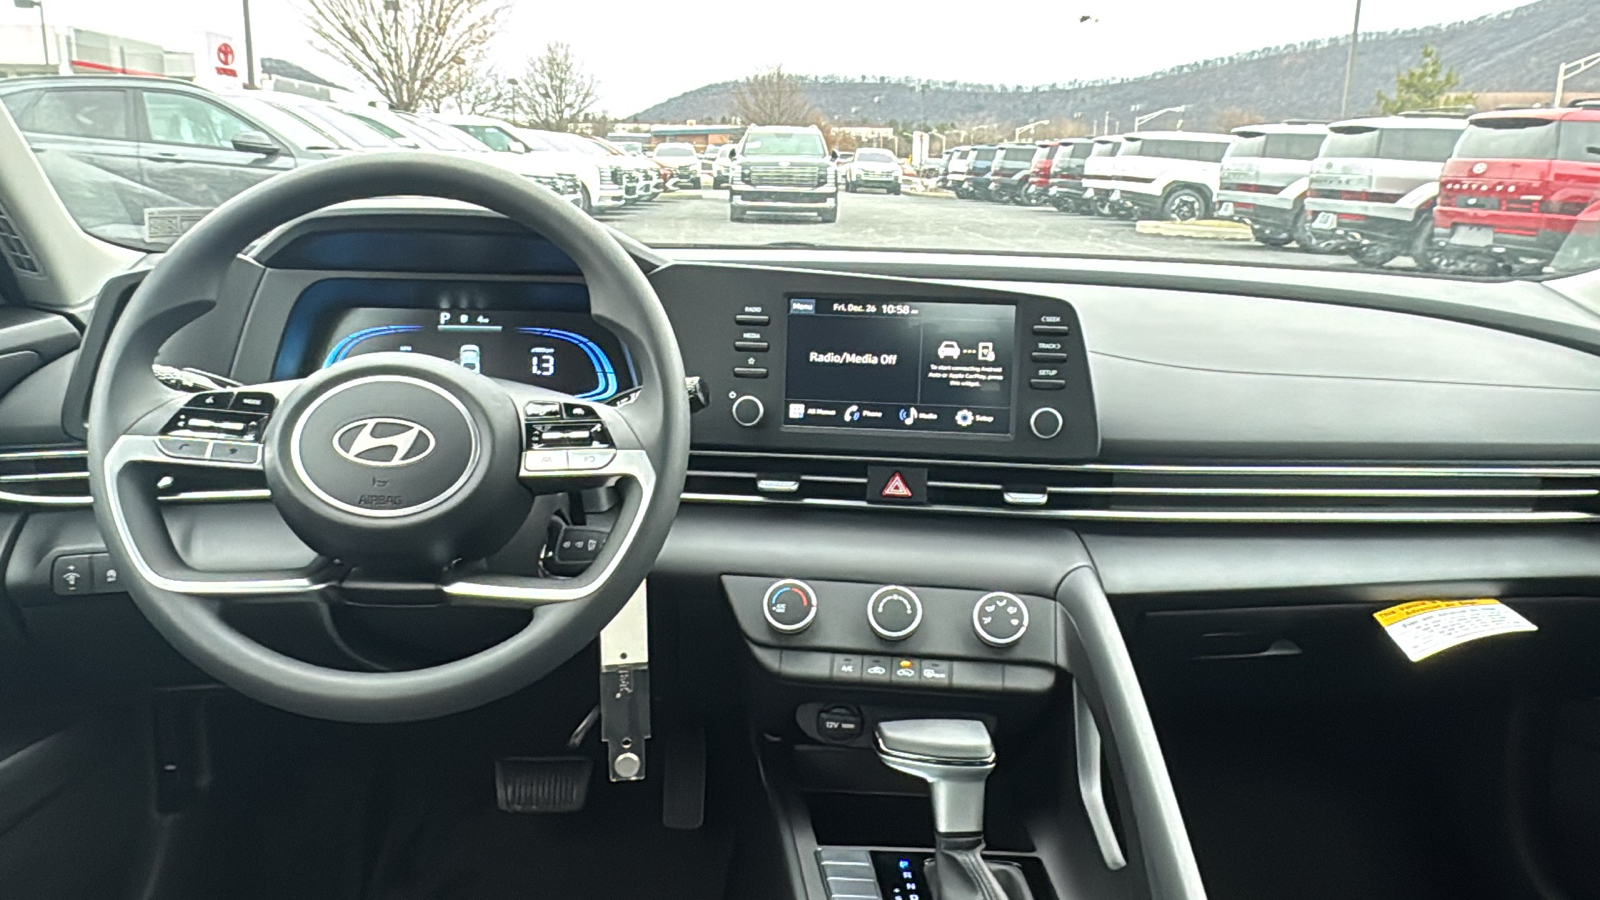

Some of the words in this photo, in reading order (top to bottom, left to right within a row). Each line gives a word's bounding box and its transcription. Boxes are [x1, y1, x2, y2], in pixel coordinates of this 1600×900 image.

[792, 302, 813, 311] Menu
[866, 304, 877, 313] 26
[882, 304, 910, 315] 10:58
[440, 312, 451, 325] P
[809, 351, 878, 364] Radio/Media
[880, 354, 898, 365] Off
[532, 355, 555, 376] 1.3
[358, 494, 403, 506] AIRBAG
